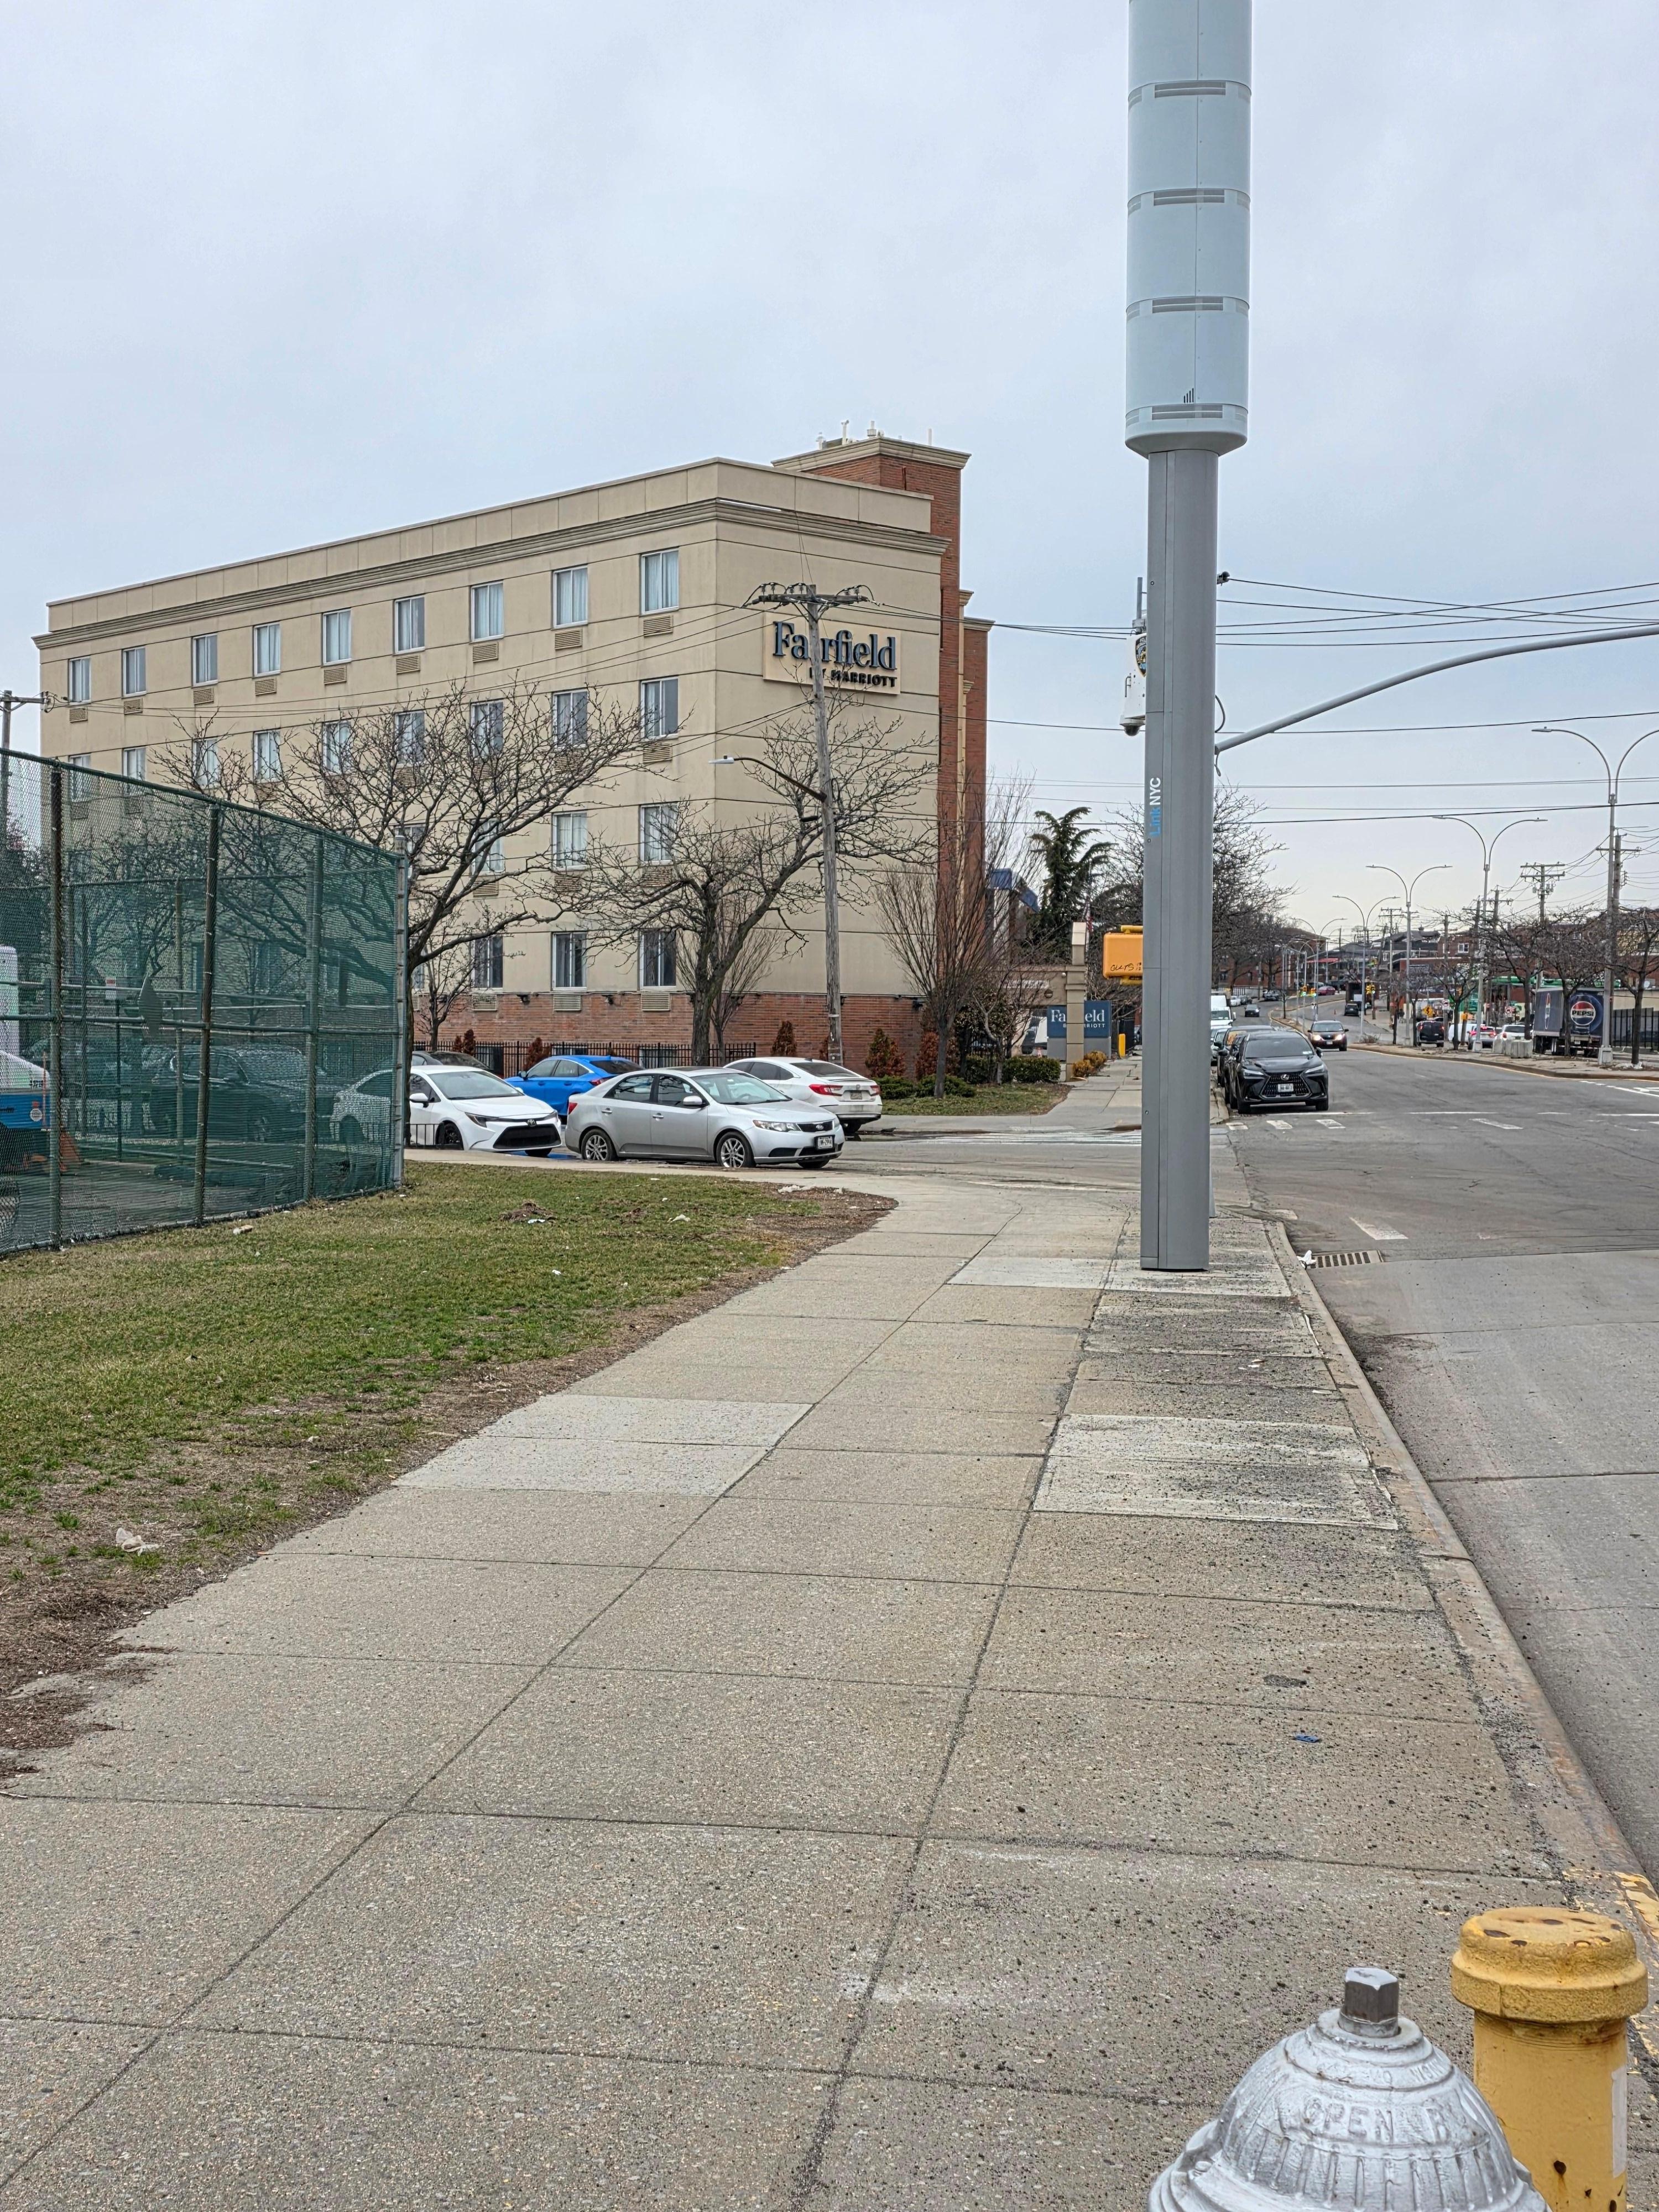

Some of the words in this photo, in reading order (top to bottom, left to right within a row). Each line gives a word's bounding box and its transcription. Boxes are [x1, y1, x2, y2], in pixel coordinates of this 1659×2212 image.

[773, 621, 898, 670] Farfield
[831, 669, 897, 687] MARRIOTT
[1051, 1010, 1105, 1022] Faeld
